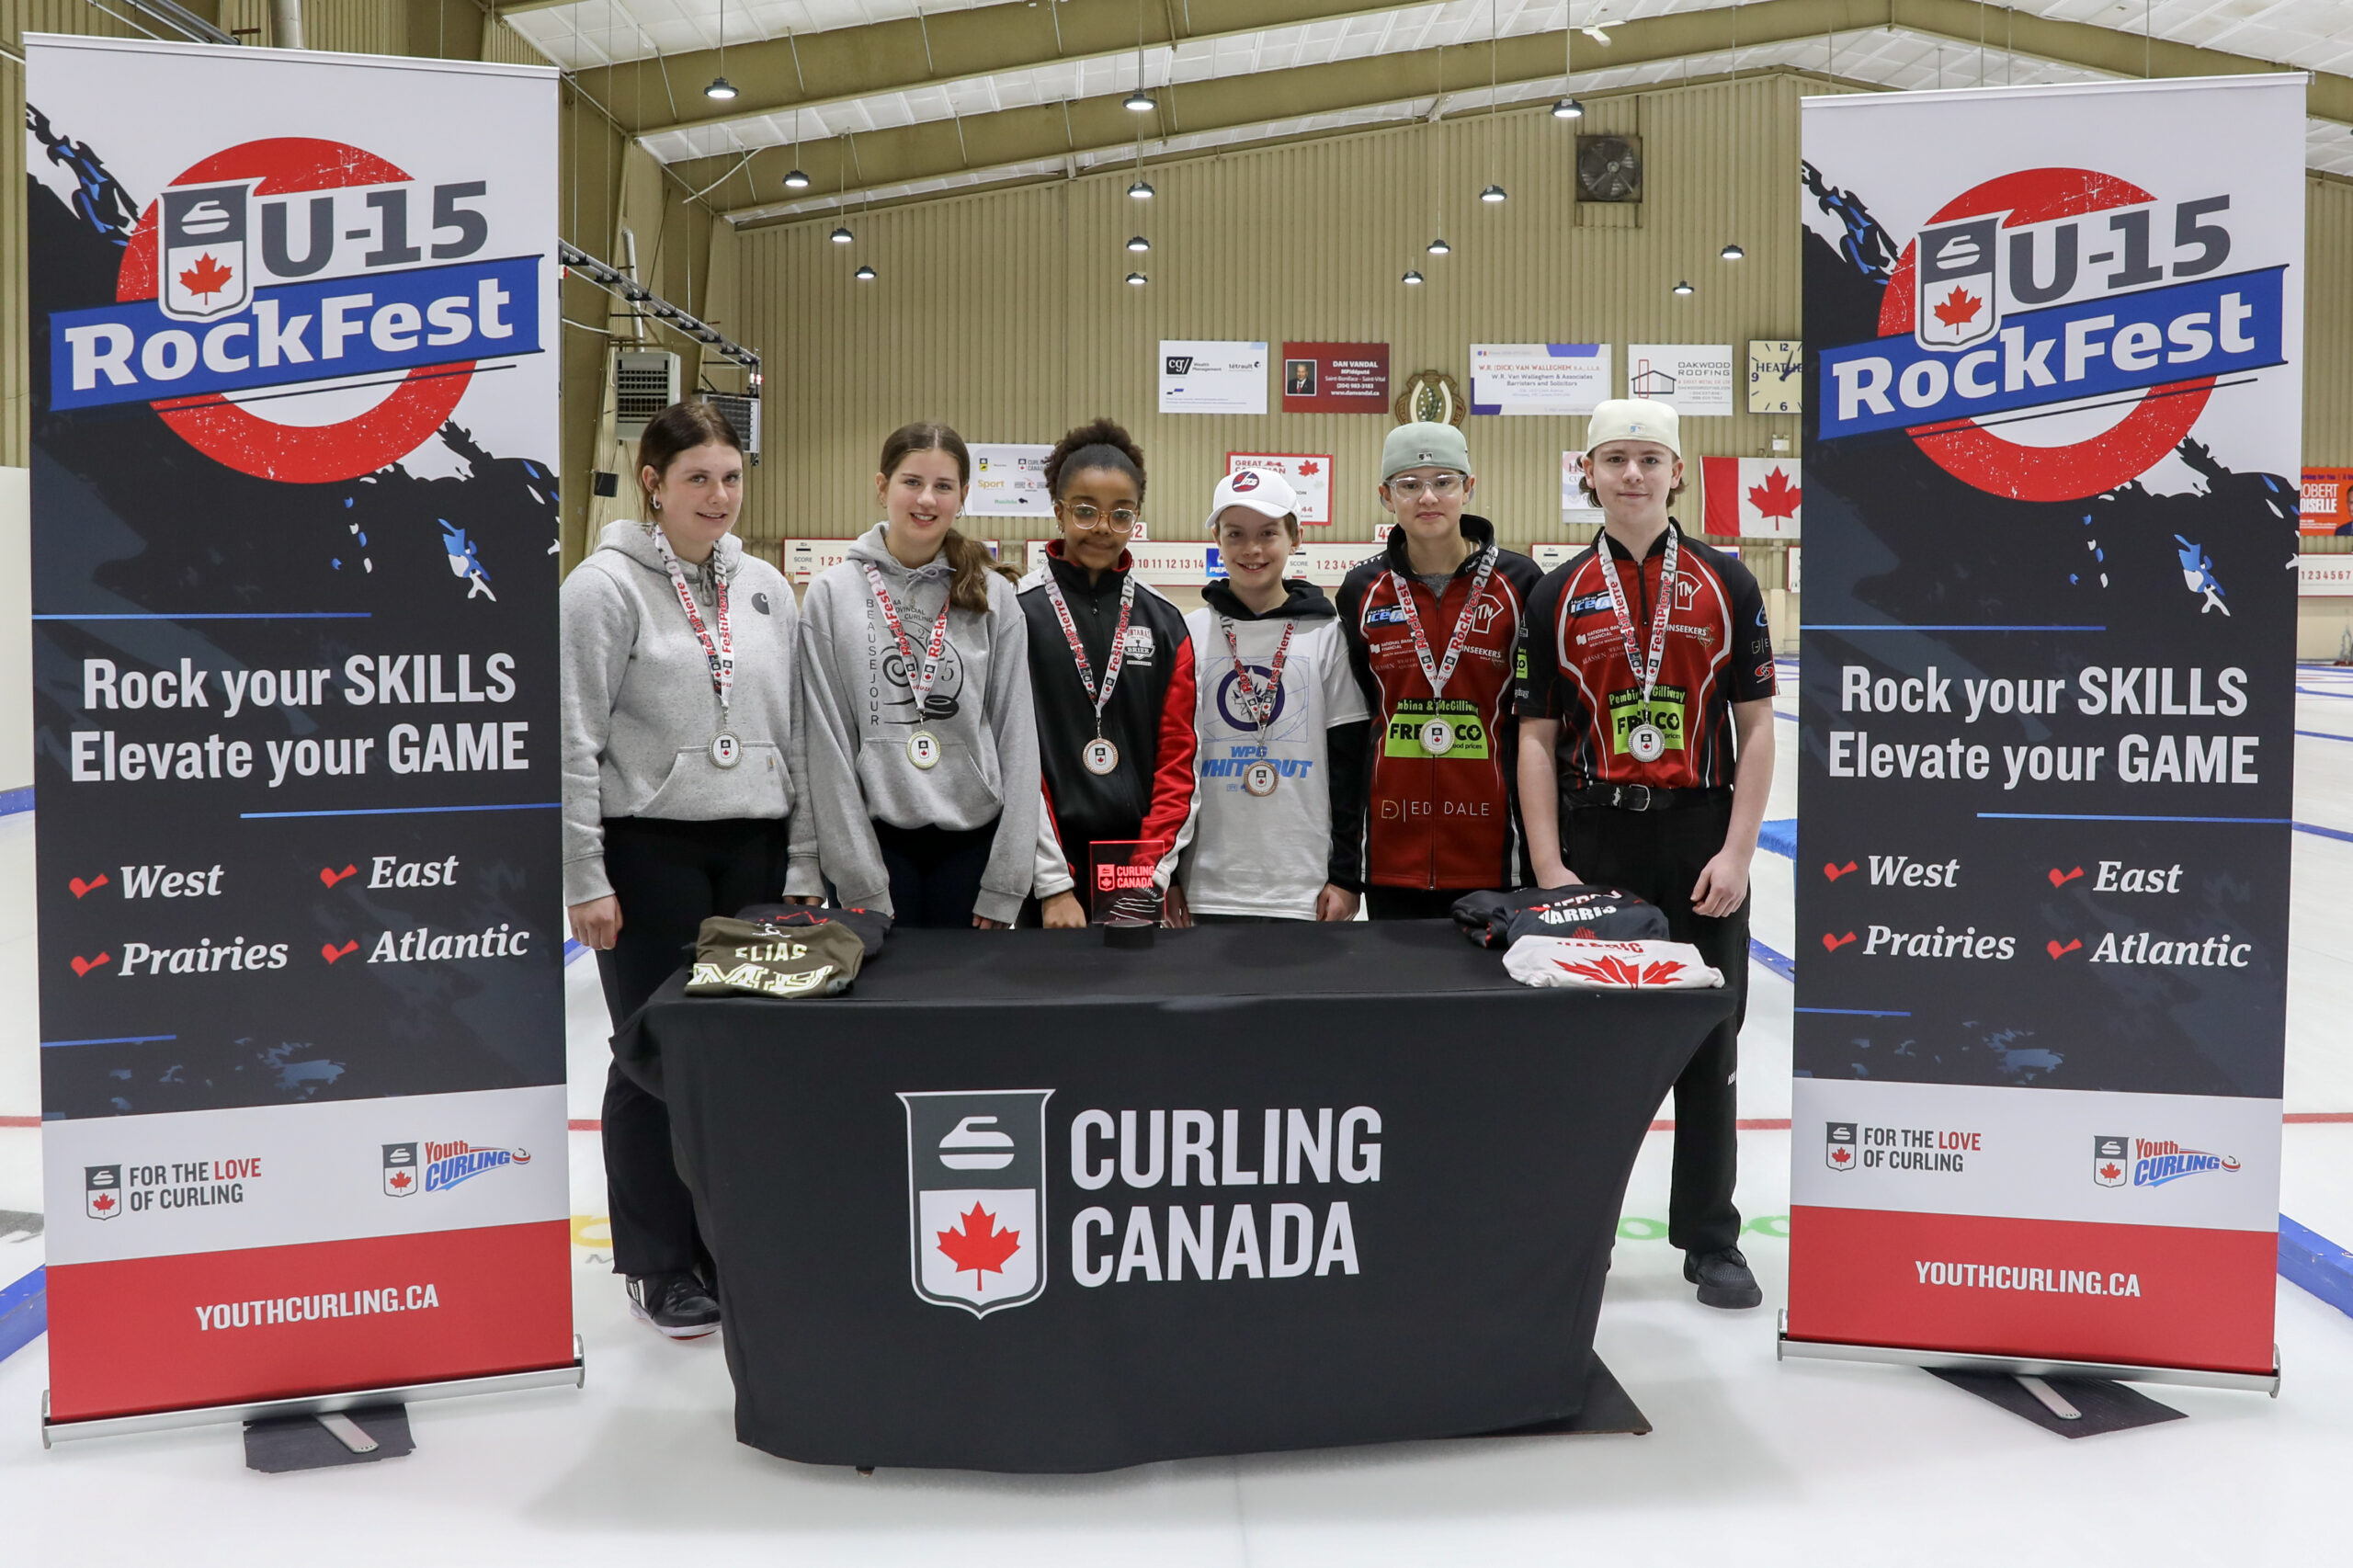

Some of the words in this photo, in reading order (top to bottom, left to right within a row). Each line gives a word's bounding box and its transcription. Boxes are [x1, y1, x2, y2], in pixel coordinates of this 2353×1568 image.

[261, 180, 488, 278] U-15
[2009, 194, 2231, 304] U-15
[65, 278, 513, 392] RockFest
[1779, 343, 1789, 351] 12
[1833, 291, 2256, 422] RockFest
[1751, 372, 1759, 382] 9
[1779, 402, 1788, 412] 6
[978, 479, 1005, 489] Sport
[2301, 483, 2339, 497] OBERT
[2300, 498, 2337, 513] OISELLE
[828, 557, 834, 565] 2
[1138, 559, 1149, 568] 10
[1152, 559, 1162, 568] 11
[1165, 559, 1176, 568] 12
[1180, 559, 1190, 568] 13
[1194, 560, 1204, 568] 14
[1324, 561, 1330, 569] 2
[1333, 561, 1338, 569] 3
[1341, 561, 1346, 569] 4
[875, 588, 913, 656] RockFest
[1397, 584, 1428, 650] RockFest
[1449, 583, 1483, 651] RockFest
[1586, 628, 1609, 636] NATIONAL
[1667, 624, 1707, 636] INSEEKERS
[1461, 644, 1501, 658] INSEEKERS
[84, 658, 210, 710] Rock
[222, 666, 331, 718] your
[344, 653, 516, 705] SKILLS
[1841, 665, 1952, 714] Rock
[1963, 676, 2065, 724] your
[2077, 666, 2249, 717] SKILLS
[1427, 700, 1434, 711] &
[71, 730, 253, 782] Elevate
[267, 736, 373, 788] your
[388, 722, 530, 774] GAME
[1231, 745, 1267, 757] WPG
[1828, 731, 1990, 779] Elevate
[2003, 743, 2105, 790] your
[2117, 733, 2259, 784] GAME
[1444, 801, 1490, 816] DALE
[120, 864, 224, 899] West
[368, 855, 459, 889] East
[1117, 866, 1155, 877] CURLING
[1117, 877, 1154, 888] CANADA
[1868, 855, 1961, 888] West
[2093, 860, 2183, 893] East
[118, 936, 289, 977] Prairies
[368, 923, 529, 963] Atlantic
[1862, 924, 2016, 961] Prairies
[2090, 931, 2252, 968] Atlantic
[425, 1141, 469, 1162] Youth
[1071, 1106, 1381, 1190] CURLING
[1864, 1127, 1897, 1147] FOR
[1902, 1129, 1934, 1149] THE
[1938, 1131, 1982, 1152] LOVE
[2135, 1137, 2179, 1157] Youth
[130, 1165, 166, 1187] FOR
[172, 1163, 210, 1184] THE
[214, 1157, 262, 1180] LOVE
[426, 1148, 511, 1192] CURLING
[1863, 1149, 1884, 1169] OF
[1889, 1150, 1964, 1173] CURLING
[2133, 1153, 2221, 1187] CURLING
[130, 1191, 153, 1211] OF
[159, 1184, 244, 1210] CURLING
[1072, 1201, 1359, 1288] CANADA
[1915, 1261, 2141, 1298] YOUTHCURLING.CA
[195, 1283, 439, 1332] YOUTHCURLING.CA
